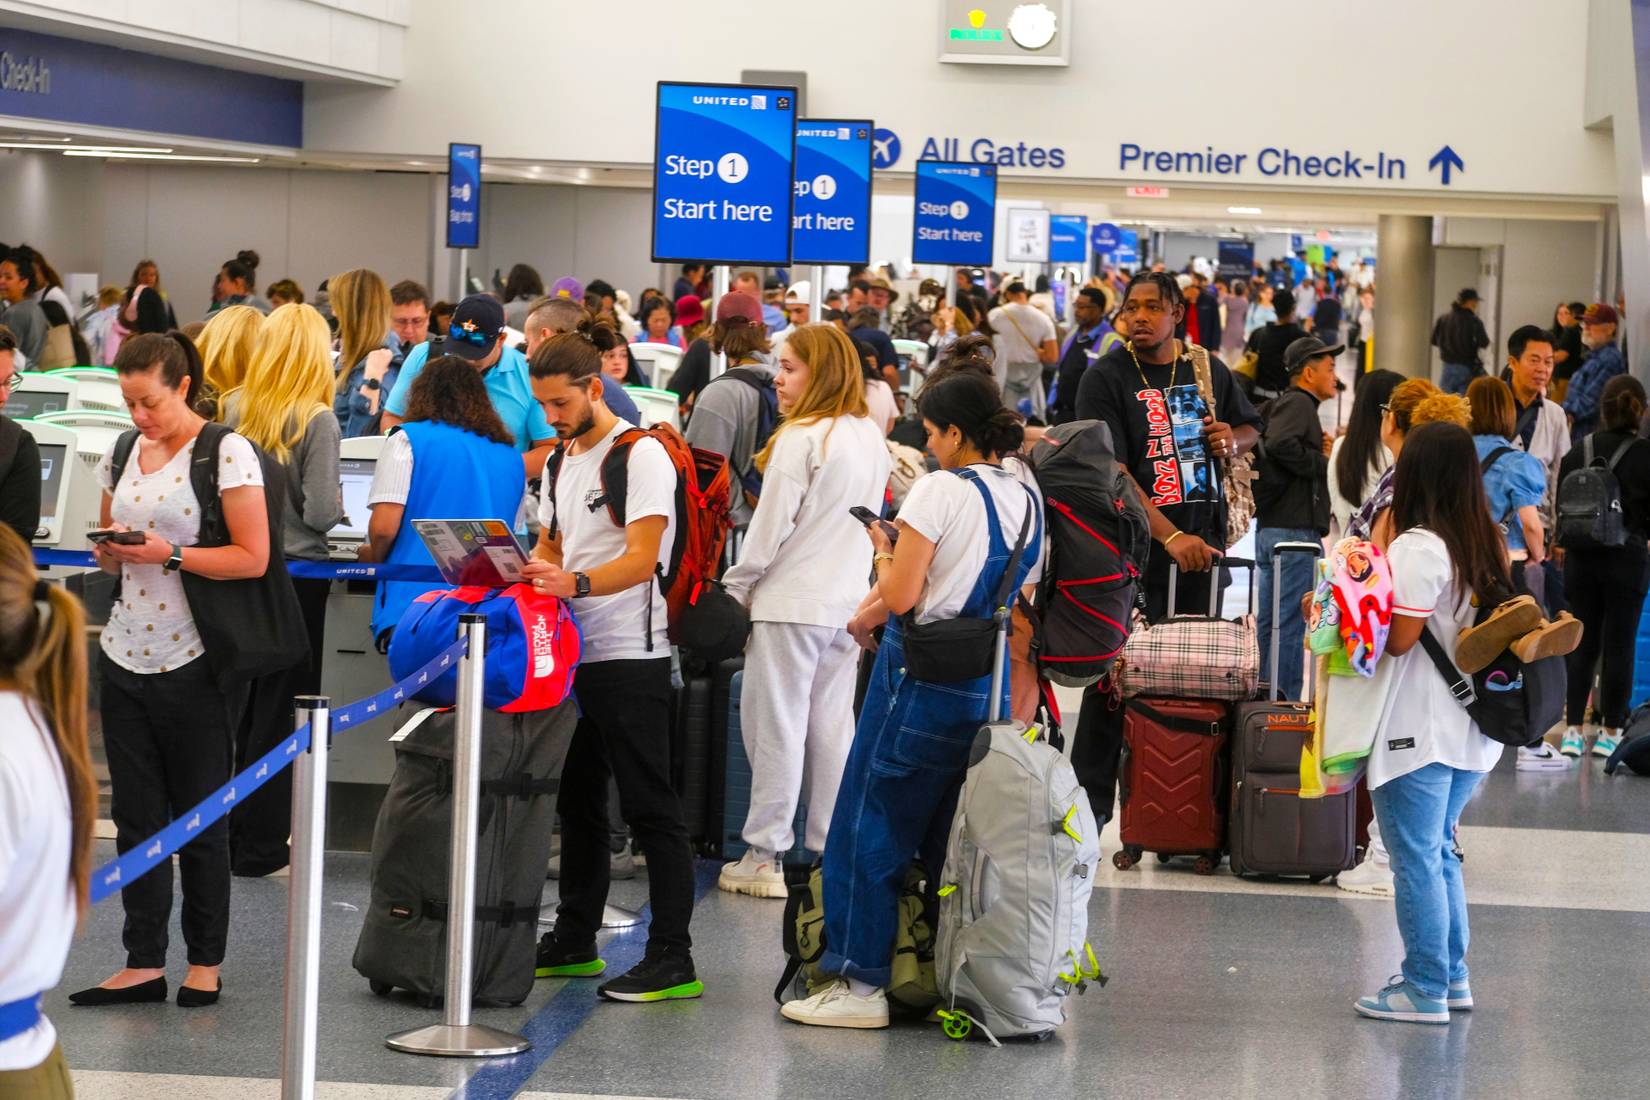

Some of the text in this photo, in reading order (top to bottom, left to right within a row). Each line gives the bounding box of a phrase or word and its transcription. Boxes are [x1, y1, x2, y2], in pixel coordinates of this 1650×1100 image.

[1, 52, 50, 95] Check-In
[693, 95, 749, 106] UNITED
[919, 137, 1066, 169] All Gates
[1119, 143, 1406, 180] Premier Check-In
[665, 154, 715, 180] Step
[793, 180, 811, 198] ep
[663, 198, 774, 223] Start here
[792, 212, 856, 232] art here
[918, 202, 950, 218] Step
[918, 227, 984, 243] Start here
[531, 624, 541, 656] FACE
[536, 613, 547, 656] NORTH
[545, 630, 554, 655] THE
[1267, 714, 1308, 723] NAUT
